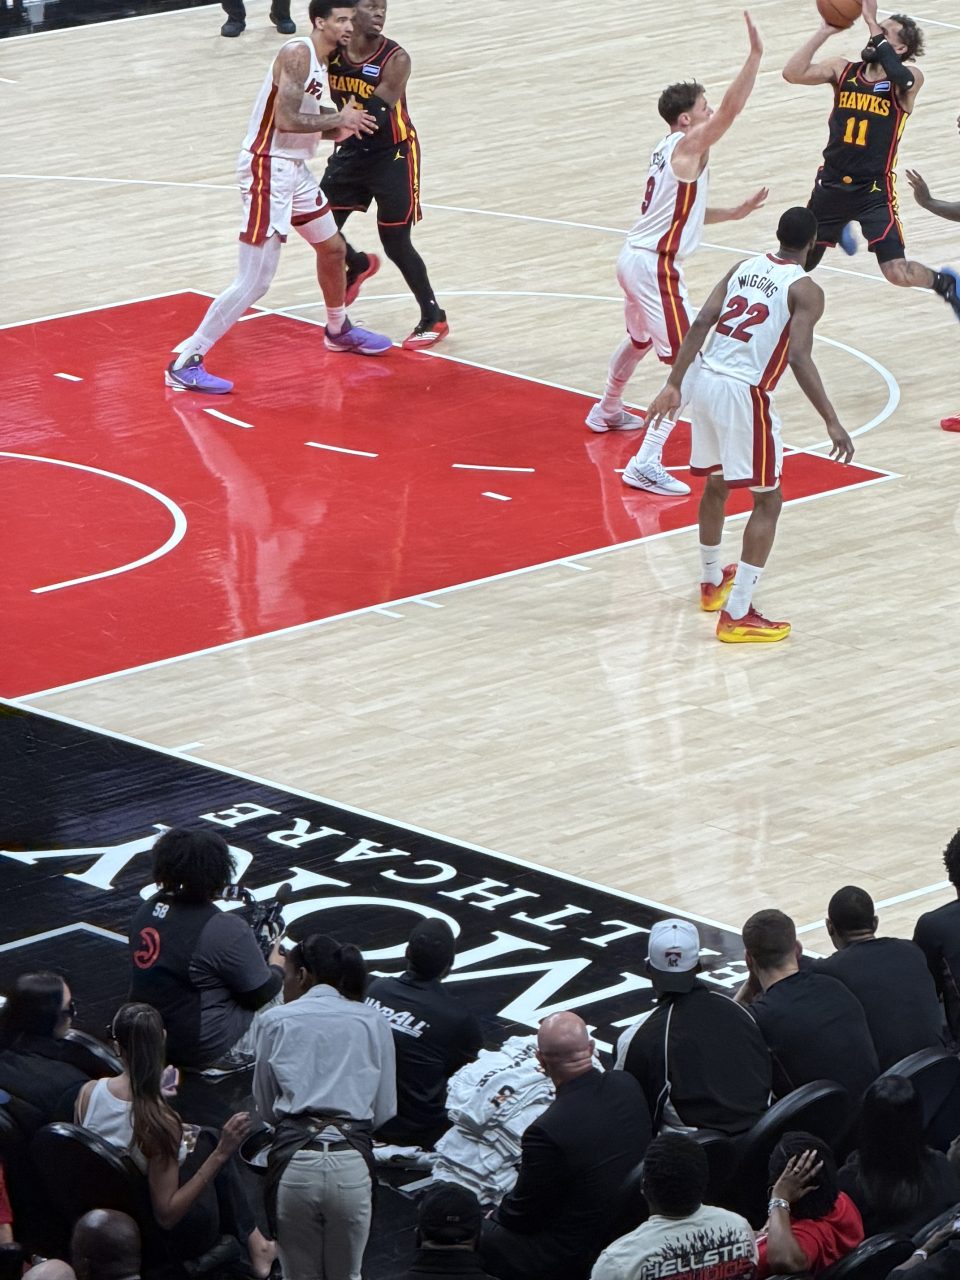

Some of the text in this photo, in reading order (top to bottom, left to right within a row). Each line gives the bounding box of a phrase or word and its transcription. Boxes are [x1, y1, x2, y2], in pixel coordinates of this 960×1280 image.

[329, 74, 375, 99] HAWKS
[838, 91, 891, 117] HAWKS
[843, 116, 869, 146] 11
[641, 175, 656, 215] 9
[737, 273, 779, 299] WIGGINS
[715, 294, 770, 343] 22
[152, 902, 170, 919] 58
[198, 802, 751, 989] ELTHCARE
[0, 823, 662, 1056] MORY
[641, 1240, 756, 1280] HELLSTAR
